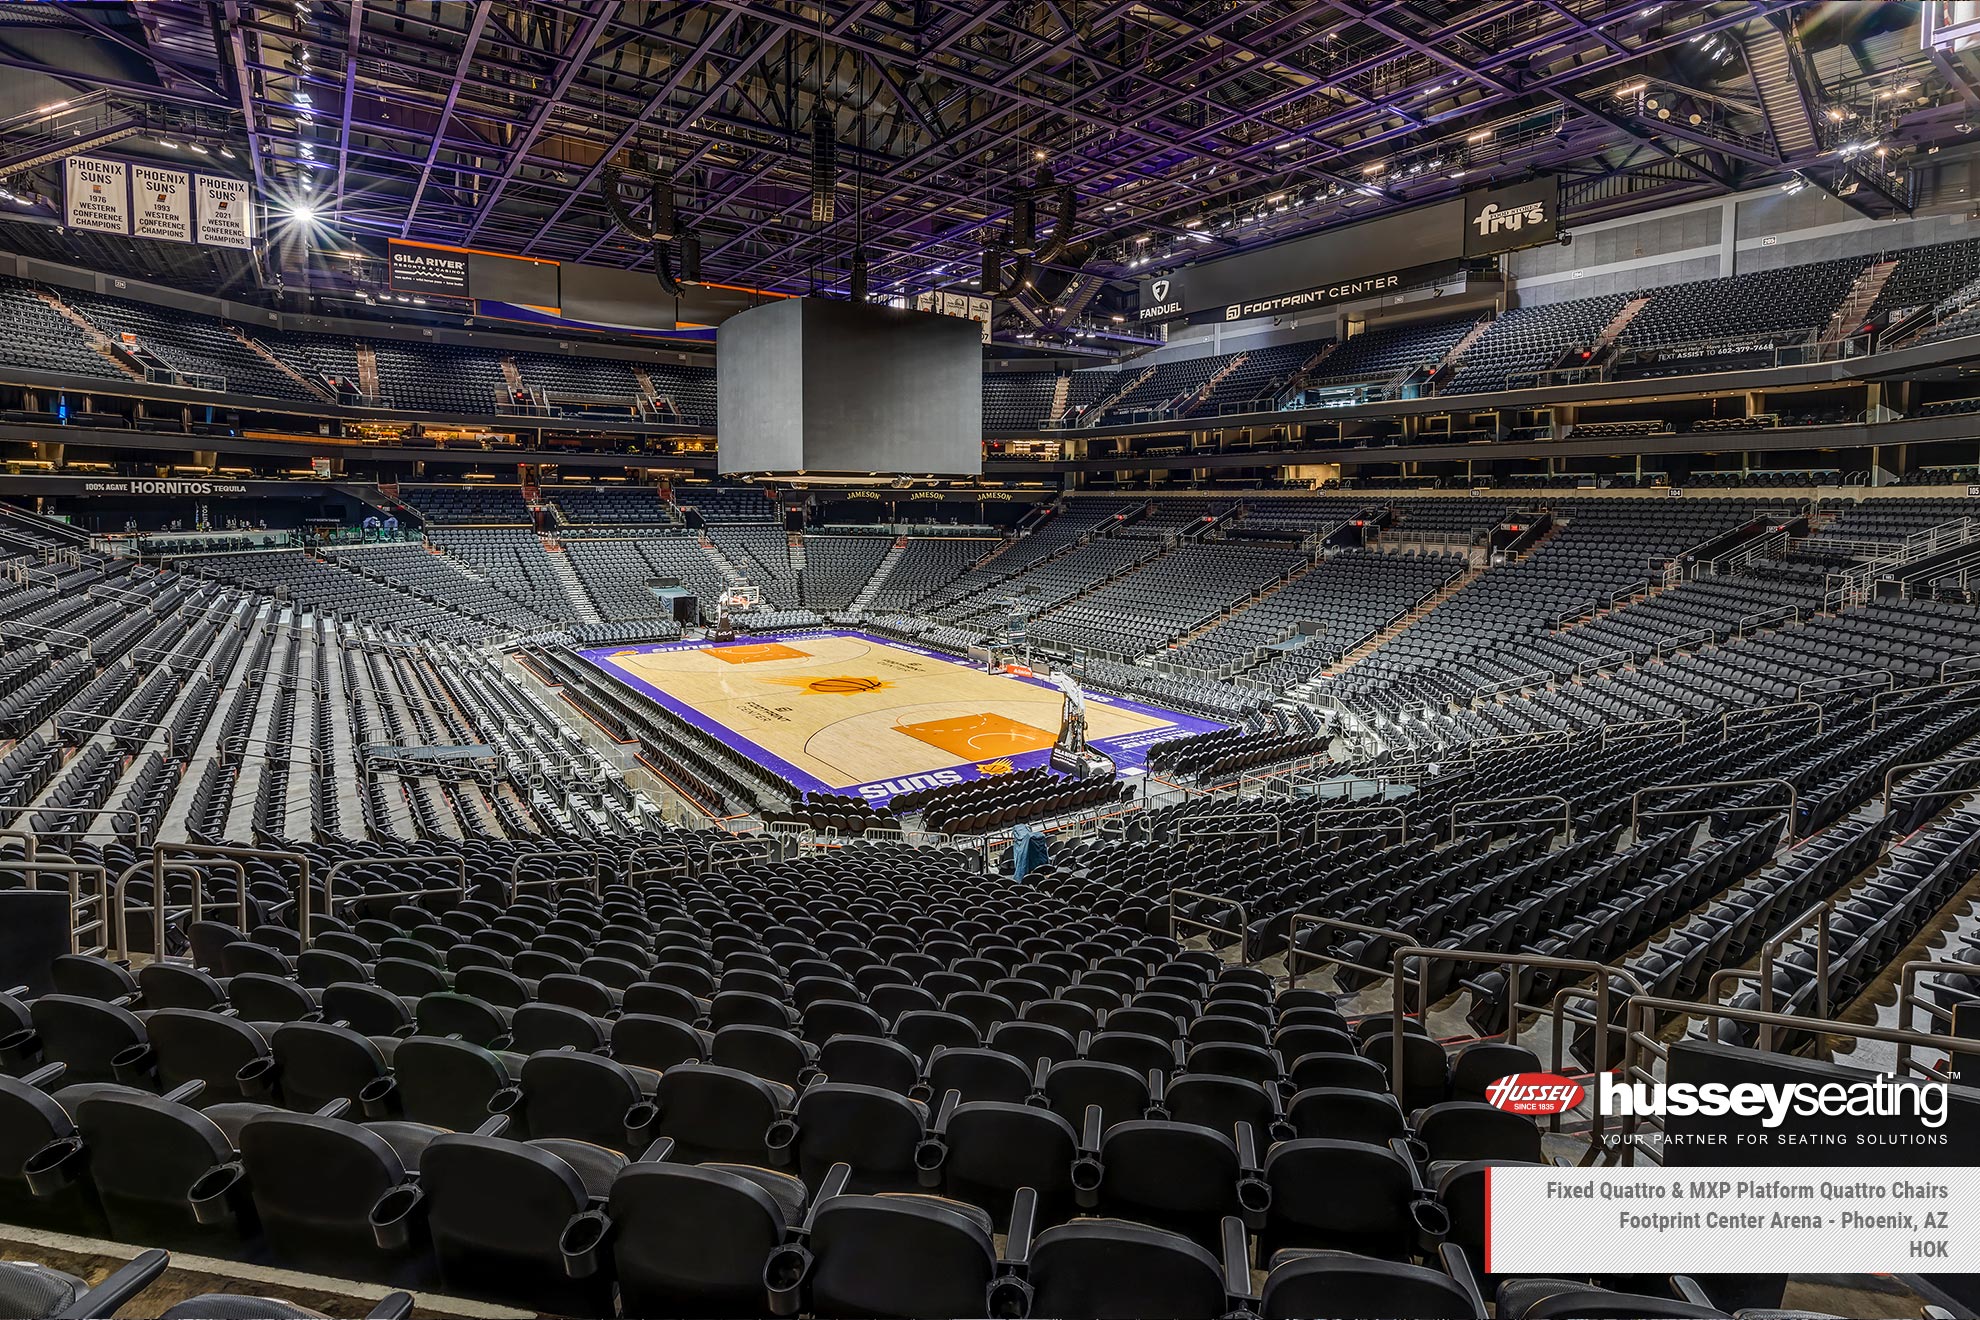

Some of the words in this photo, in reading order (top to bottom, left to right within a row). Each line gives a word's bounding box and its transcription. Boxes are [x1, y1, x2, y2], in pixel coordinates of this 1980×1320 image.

[70, 158, 122, 175] PHOENIX
[81, 172, 112, 184] SUNS
[136, 169, 186, 185] PHOENIX
[146, 181, 176, 194] SUNS
[200, 178, 244, 192] PHOENIX
[89, 195, 106, 203] 1976
[209, 190, 236, 201] SUNS
[80, 202, 116, 212] WESTERN
[154, 204, 170, 212] 1993
[73, 210, 123, 222] CONFERENCE
[145, 211, 179, 221] WESTERN
[76, 218, 121, 230] CHAMPIONS
[139, 218, 186, 230] CONFERENCE
[208, 218, 240, 228] WESTERN
[141, 227, 184, 238] CHAMPIONS
[202, 226, 246, 237] CONFERENCE
[204, 234, 244, 245] CHAMPIONS
[394, 254, 424, 264] GILA
[426, 258, 464, 270] RIVER
[1244, 290, 1325, 314] FOOTPRINT
[1328, 276, 1398, 298] CENTER
[1140, 302, 1182, 319] FANDUEL
[1677, 351, 1704, 359] ASSIST
[131, 482, 210, 493] HORNITOS
[846, 491, 880, 500] JAMESON
[911, 491, 945, 500] JAMESON
[977, 492, 1012, 501] JAMESON
